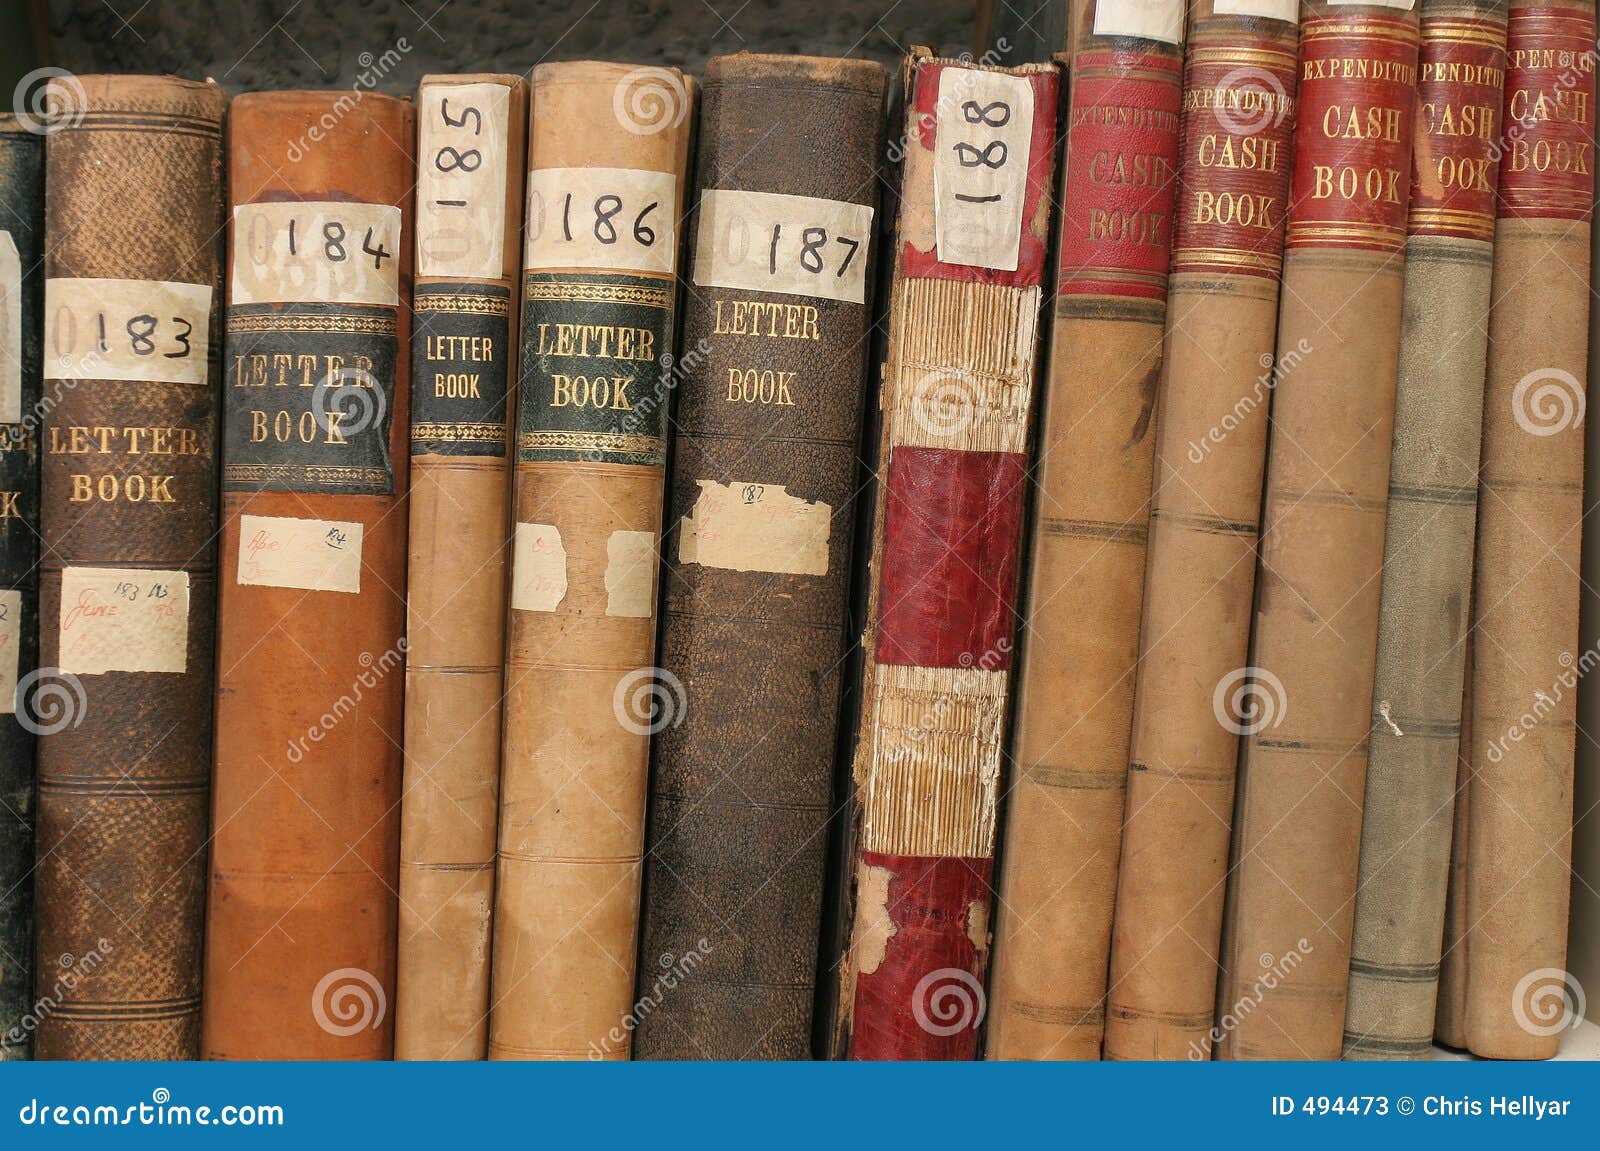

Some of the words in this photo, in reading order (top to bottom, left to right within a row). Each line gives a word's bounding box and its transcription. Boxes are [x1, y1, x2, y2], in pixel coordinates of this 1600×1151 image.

[1323, 104, 1401, 143] CASH
[435, 98, 482, 206] 185
[953, 100, 1011, 203] 188
[1198, 133, 1280, 173] CASH
[1508, 140, 1590, 175] BOOK
[1089, 151, 1169, 191] CASH
[1312, 165, 1401, 205] BOOK
[1437, 156, 1492, 194] OOK
[1088, 207, 1166, 247] BOOK
[1194, 191, 1276, 229] BOOK
[713, 300, 820, 341] LETTER
[426, 335, 493, 362] LETTER
[536, 323, 655, 362] LETTER
[234, 354, 374, 388] LETTER
[435, 375, 481, 399] BOOK
[726, 368, 796, 406] BOOK
[550, 374, 635, 411] BOOK
[50, 426, 200, 455] LETTER
[250, 410, 348, 444] BOOK
[69, 474, 176, 502] BOOK
